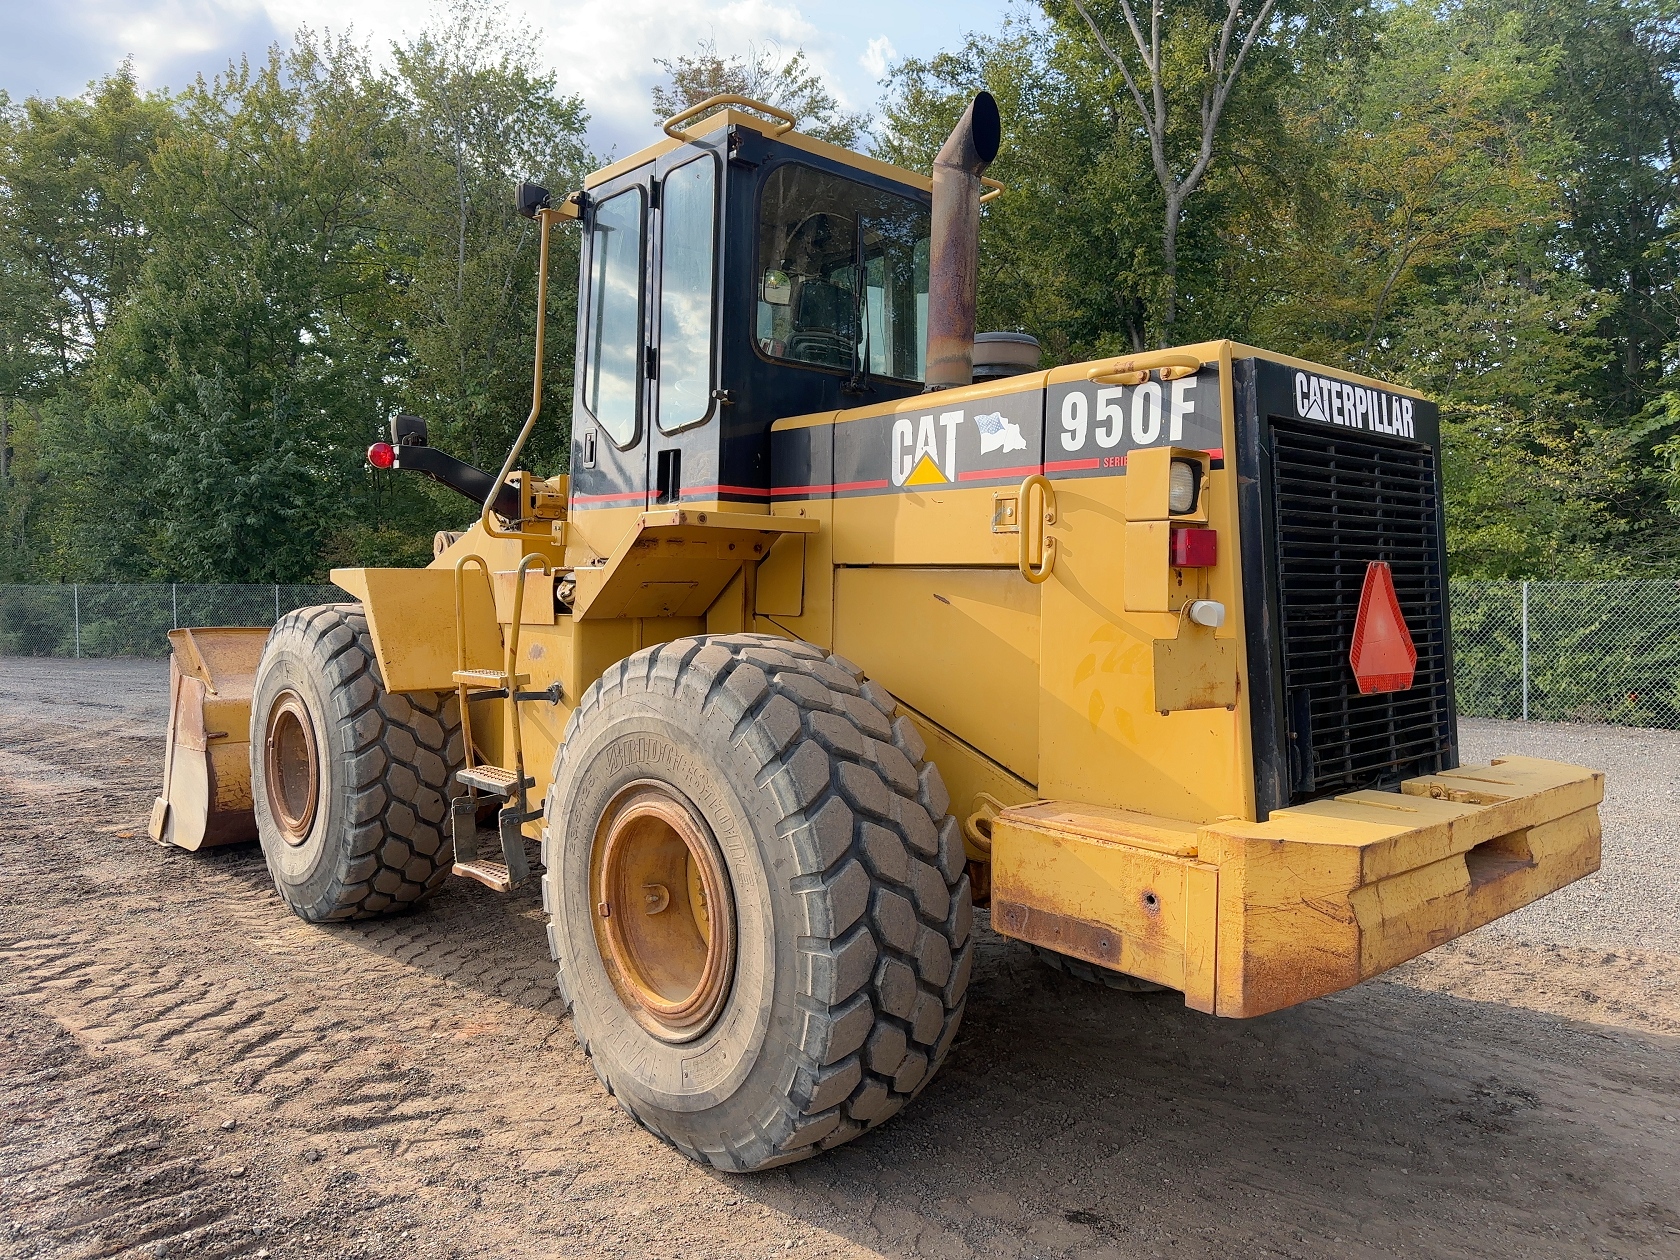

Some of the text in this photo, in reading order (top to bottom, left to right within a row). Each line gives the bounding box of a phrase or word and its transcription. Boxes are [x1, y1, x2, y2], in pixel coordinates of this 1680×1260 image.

[1060, 378, 1197, 452] 950F
[1295, 372, 1415, 438] CATERPILLAR
[892, 410, 964, 487] CAT
[1103, 455, 1128, 468] SERIE
[605, 737, 755, 888] BRIDGESTONE
